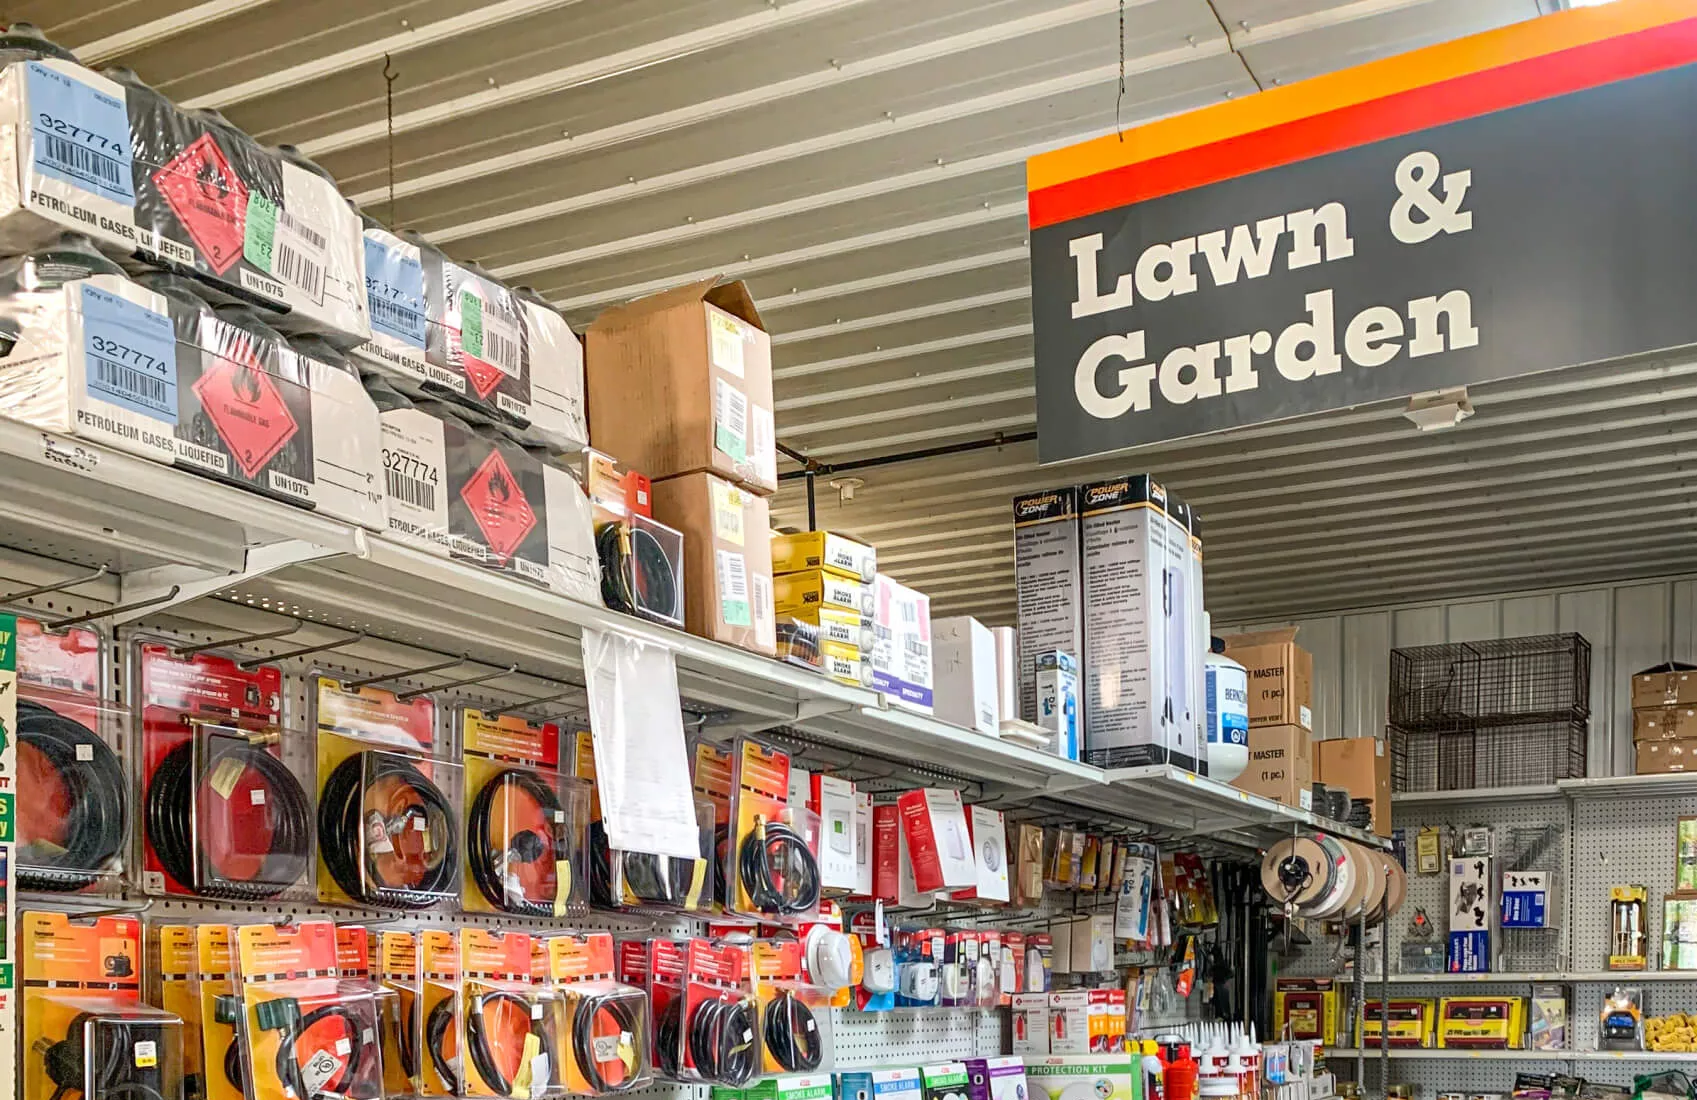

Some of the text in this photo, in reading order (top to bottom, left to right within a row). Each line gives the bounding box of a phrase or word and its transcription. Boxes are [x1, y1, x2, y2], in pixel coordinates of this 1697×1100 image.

[39, 113, 123, 156] 327774
[30, 190, 191, 262] PETROLEUM GASES, LIUEFIED
[1069, 151, 1473, 319] Lawn &
[213, 245, 221, 260] 2
[246, 273, 284, 298] UN1075
[92, 336, 168, 375] 327774
[360, 339, 400, 364] ETROLEUM
[401, 356, 428, 376] GASES,
[1074, 288, 1479, 420] Garden
[77, 409, 225, 470] PETROLEUM GASES, LIQUEFIED
[245, 450, 252, 464] 2
[381, 449, 438, 486] 327774
[274, 475, 309, 496] UN1075
[1090, 483, 1129, 496] POWER
[1020, 495, 1057, 508] POWER
[1091, 491, 1119, 502] ZONE
[1022, 503, 1049, 513] ZONE
[833, 588, 852, 599] SMOKE
[833, 593, 852, 604] ALARM
[829, 630, 849, 640] ALARM
[830, 625, 849, 635] SMOKE
[833, 660, 851, 670] SMOKE
[833, 665, 852, 675] ALARM
[1253, 667, 1284, 678] MASTER
[1254, 749, 1284, 760] MASTER
[1031, 1065, 1107, 1075] PROTECTION KIT
[785, 1087, 825, 1099] SMOKE ALARM
